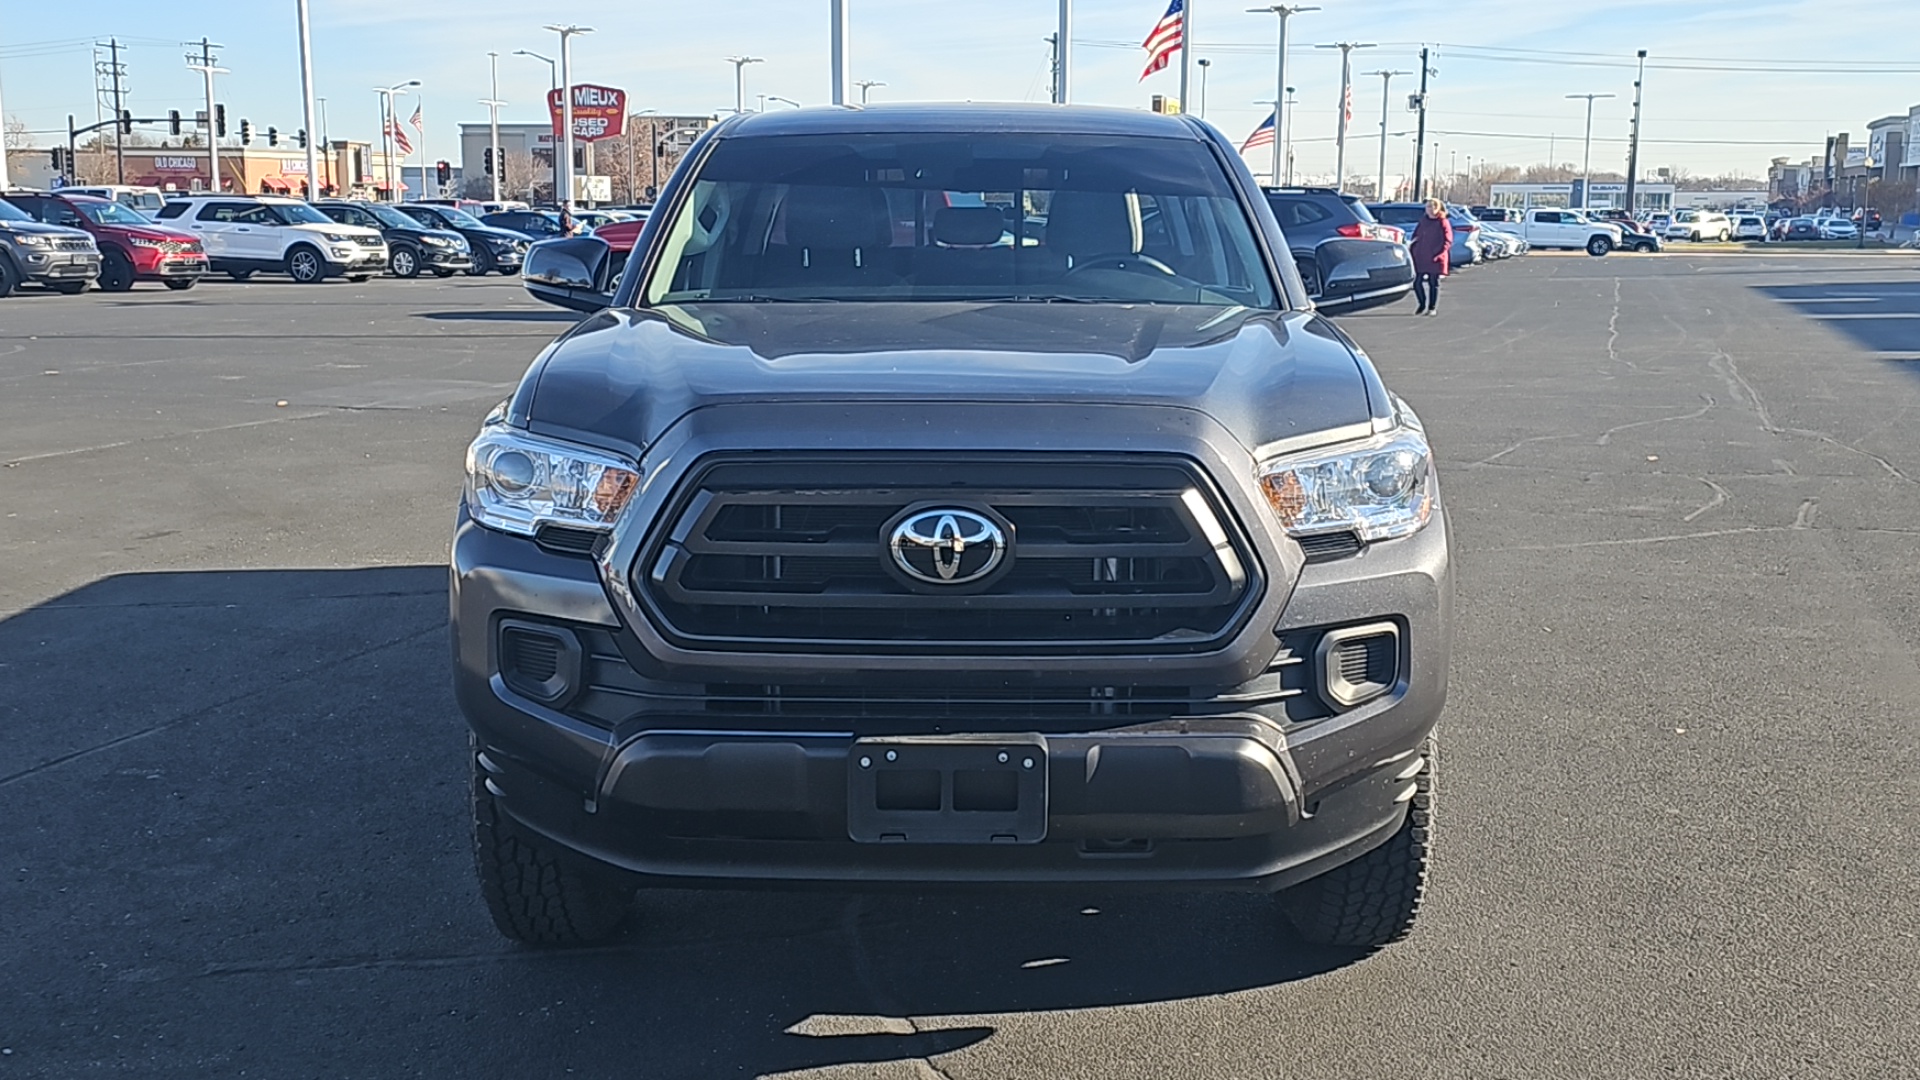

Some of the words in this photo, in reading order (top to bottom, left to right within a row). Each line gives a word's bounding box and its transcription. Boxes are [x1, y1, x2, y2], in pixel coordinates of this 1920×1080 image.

[574, 87, 618, 106] MIEUX
[573, 126, 605, 138] CARS
[154, 156, 167, 168] OLD
[168, 157, 196, 168] CHICAGO
